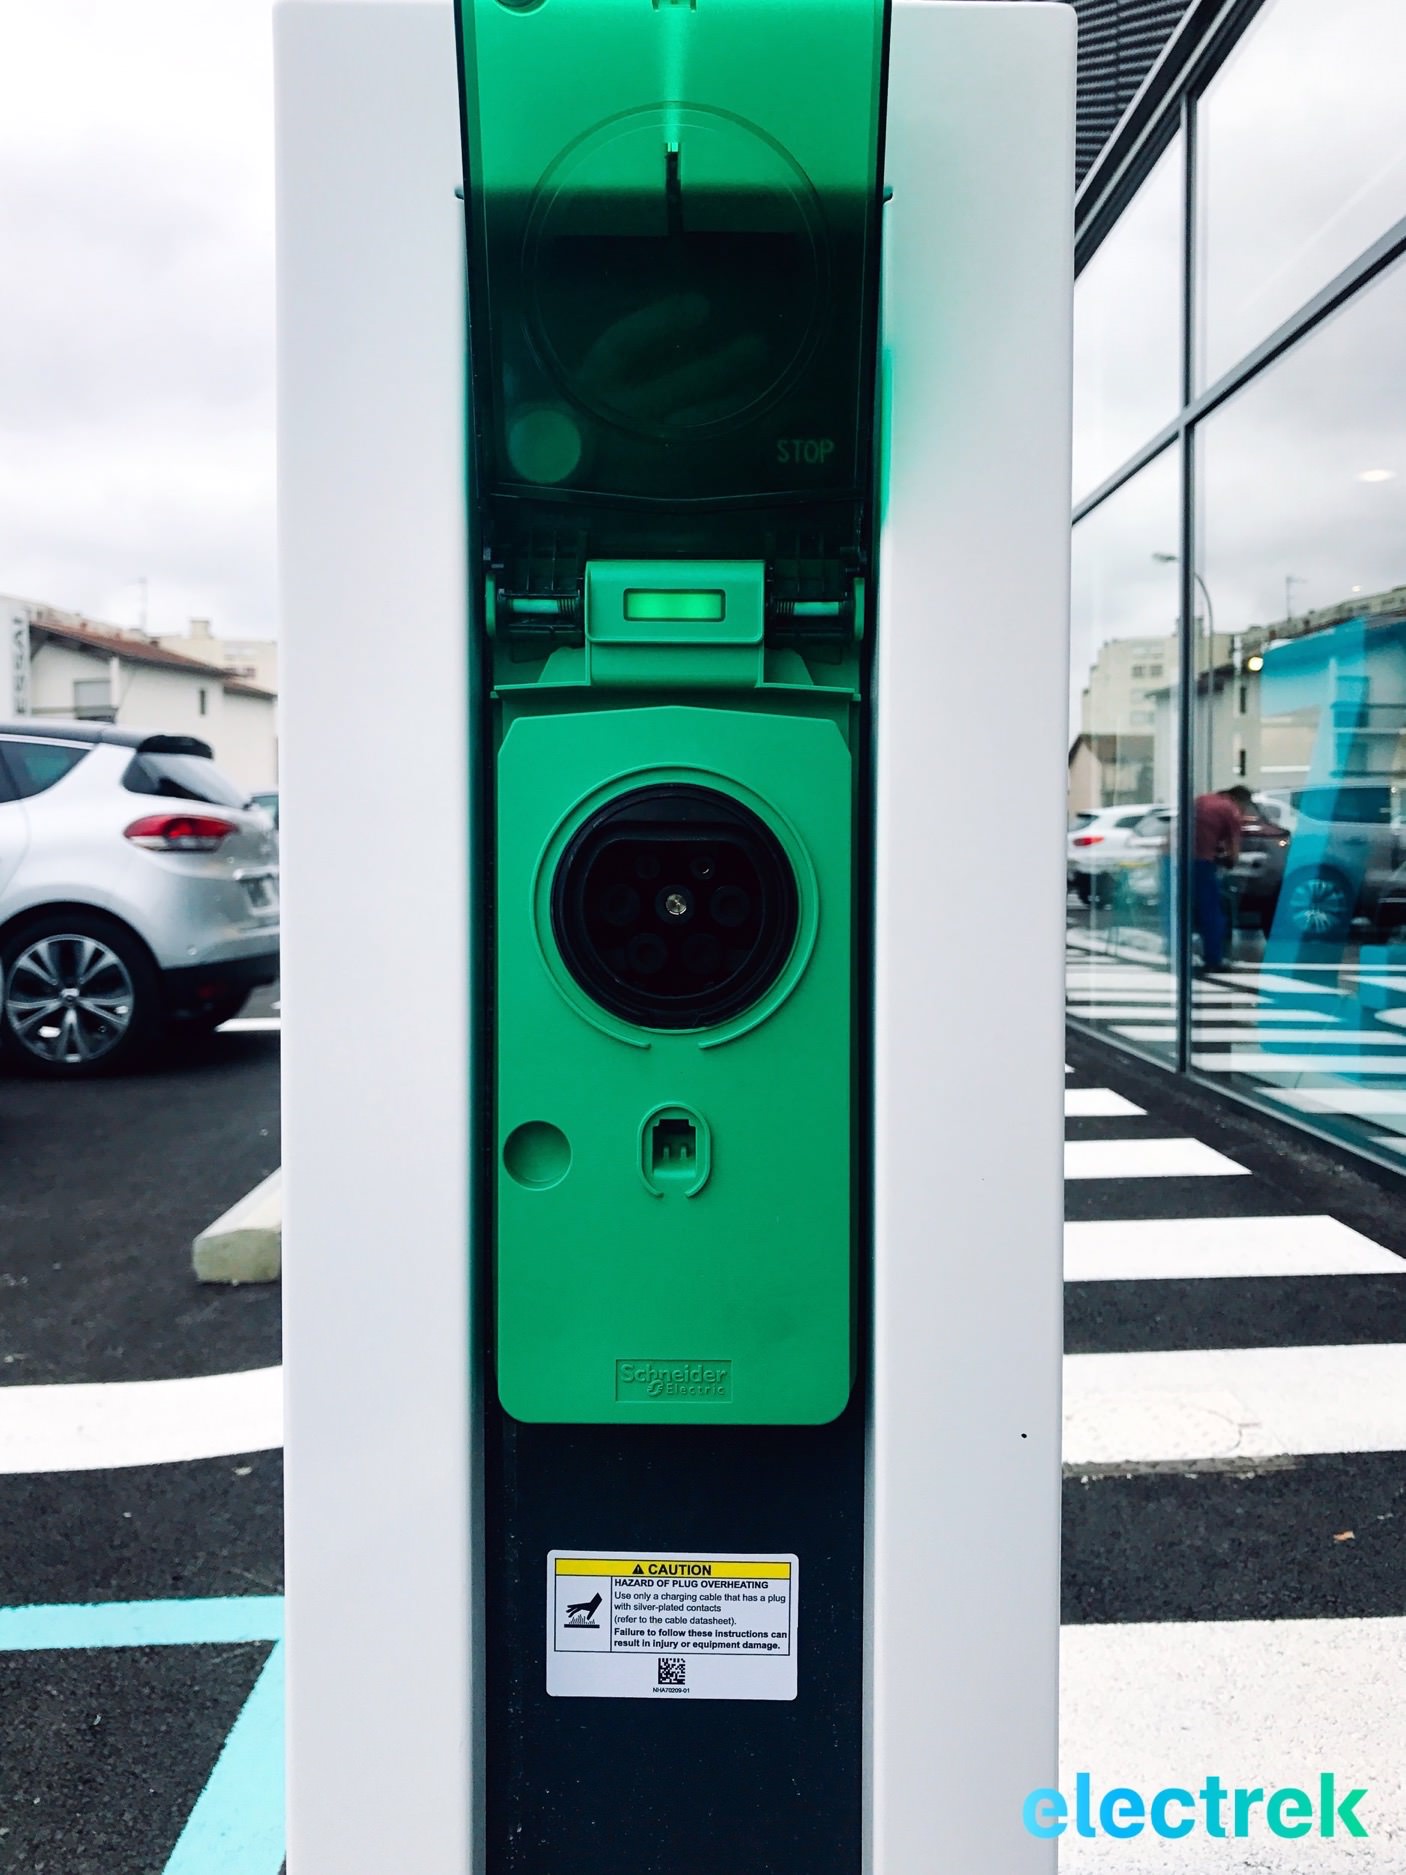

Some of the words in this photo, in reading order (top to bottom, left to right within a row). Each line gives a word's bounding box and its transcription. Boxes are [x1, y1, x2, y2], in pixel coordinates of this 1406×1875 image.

[777, 439, 835, 464] STOP
[621, 1363, 728, 1383] Schneider
[666, 1382, 726, 1396] Electric
[648, 1563, 712, 1576] CAUTION
[614, 1578, 655, 1588] HAZARD
[656, 1579, 670, 1588] OF
[672, 1579, 698, 1589] PLUG
[700, 1580, 769, 1589] OVERHEATING
[614, 1591, 631, 1600] Use
[633, 1592, 651, 1602] only
[660, 1592, 697, 1603] charging
[699, 1593, 722, 1602] cable
[724, 1593, 740, 1601] that
[742, 1593, 758, 1602] has
[767, 1593, 786, 1604] plug
[614, 1602, 631, 1611] with
[633, 1602, 684, 1613] silver-plated
[686, 1604, 722, 1613] contacts
[614, 1615, 637, 1624] (refer
[639, 1615, 647, 1624] to
[649, 1616, 663, 1624] the
[664, 1616, 688, 1625] cable
[689, 1616, 737, 1627] datasheet).
[614, 1627, 645, 1636] Failure
[647, 1628, 656, 1637] to
[658, 1628, 686, 1637] follow
[688, 1628, 713, 1637] these
[715, 1629, 769, 1638] instructions
[770, 1631, 788, 1639] can
[613, 1639, 640, 1647] result
[642, 1639, 651, 1648] in
[653, 1639, 679, 1650] injury
[692, 1640, 741, 1650] equipment
[742, 1640, 781, 1651] damage.
